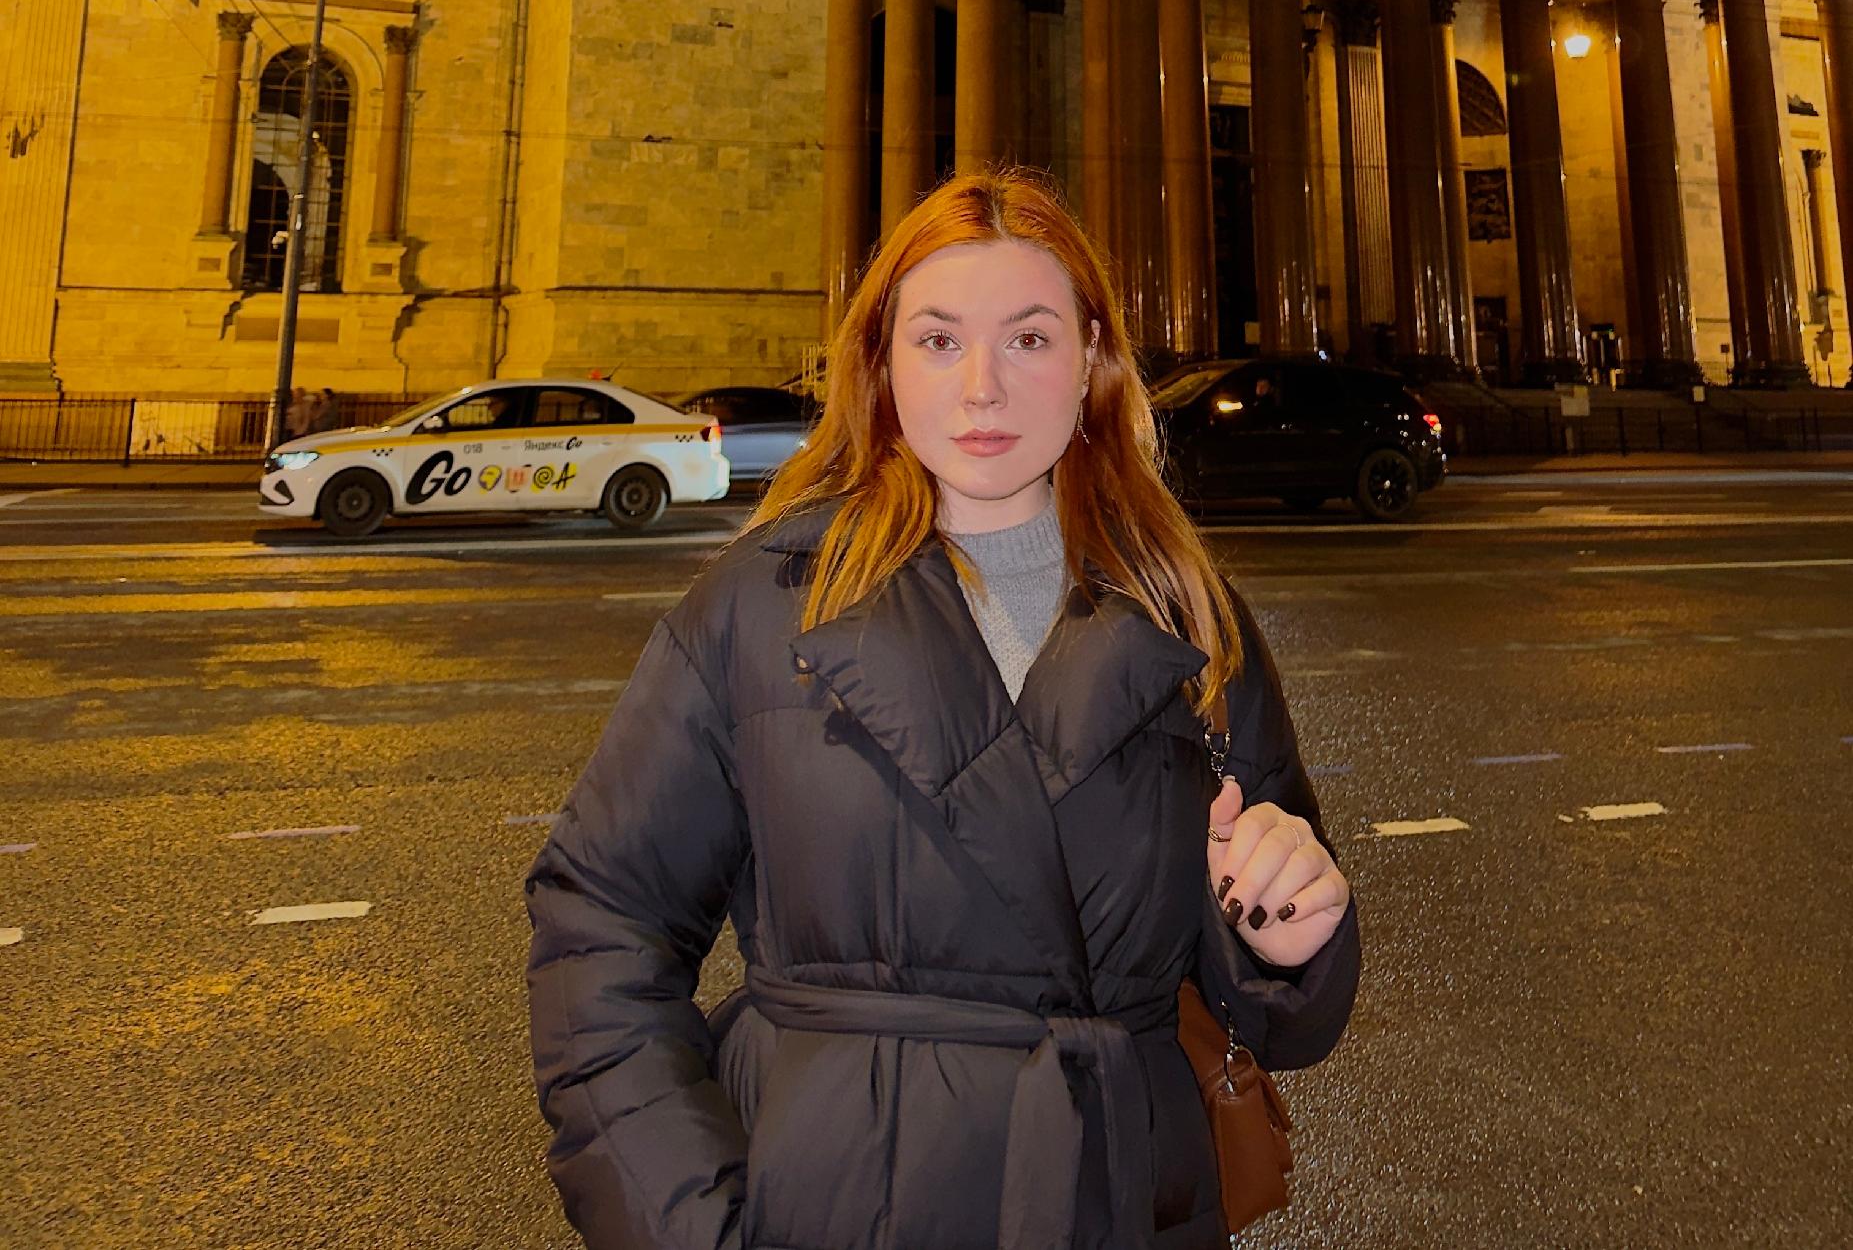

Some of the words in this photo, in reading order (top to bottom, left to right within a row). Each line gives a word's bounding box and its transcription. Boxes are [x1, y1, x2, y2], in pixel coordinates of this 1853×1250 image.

[524, 439, 563, 452] Яндекс
[566, 436, 583, 451] Go
[405, 449, 472, 505] Go
